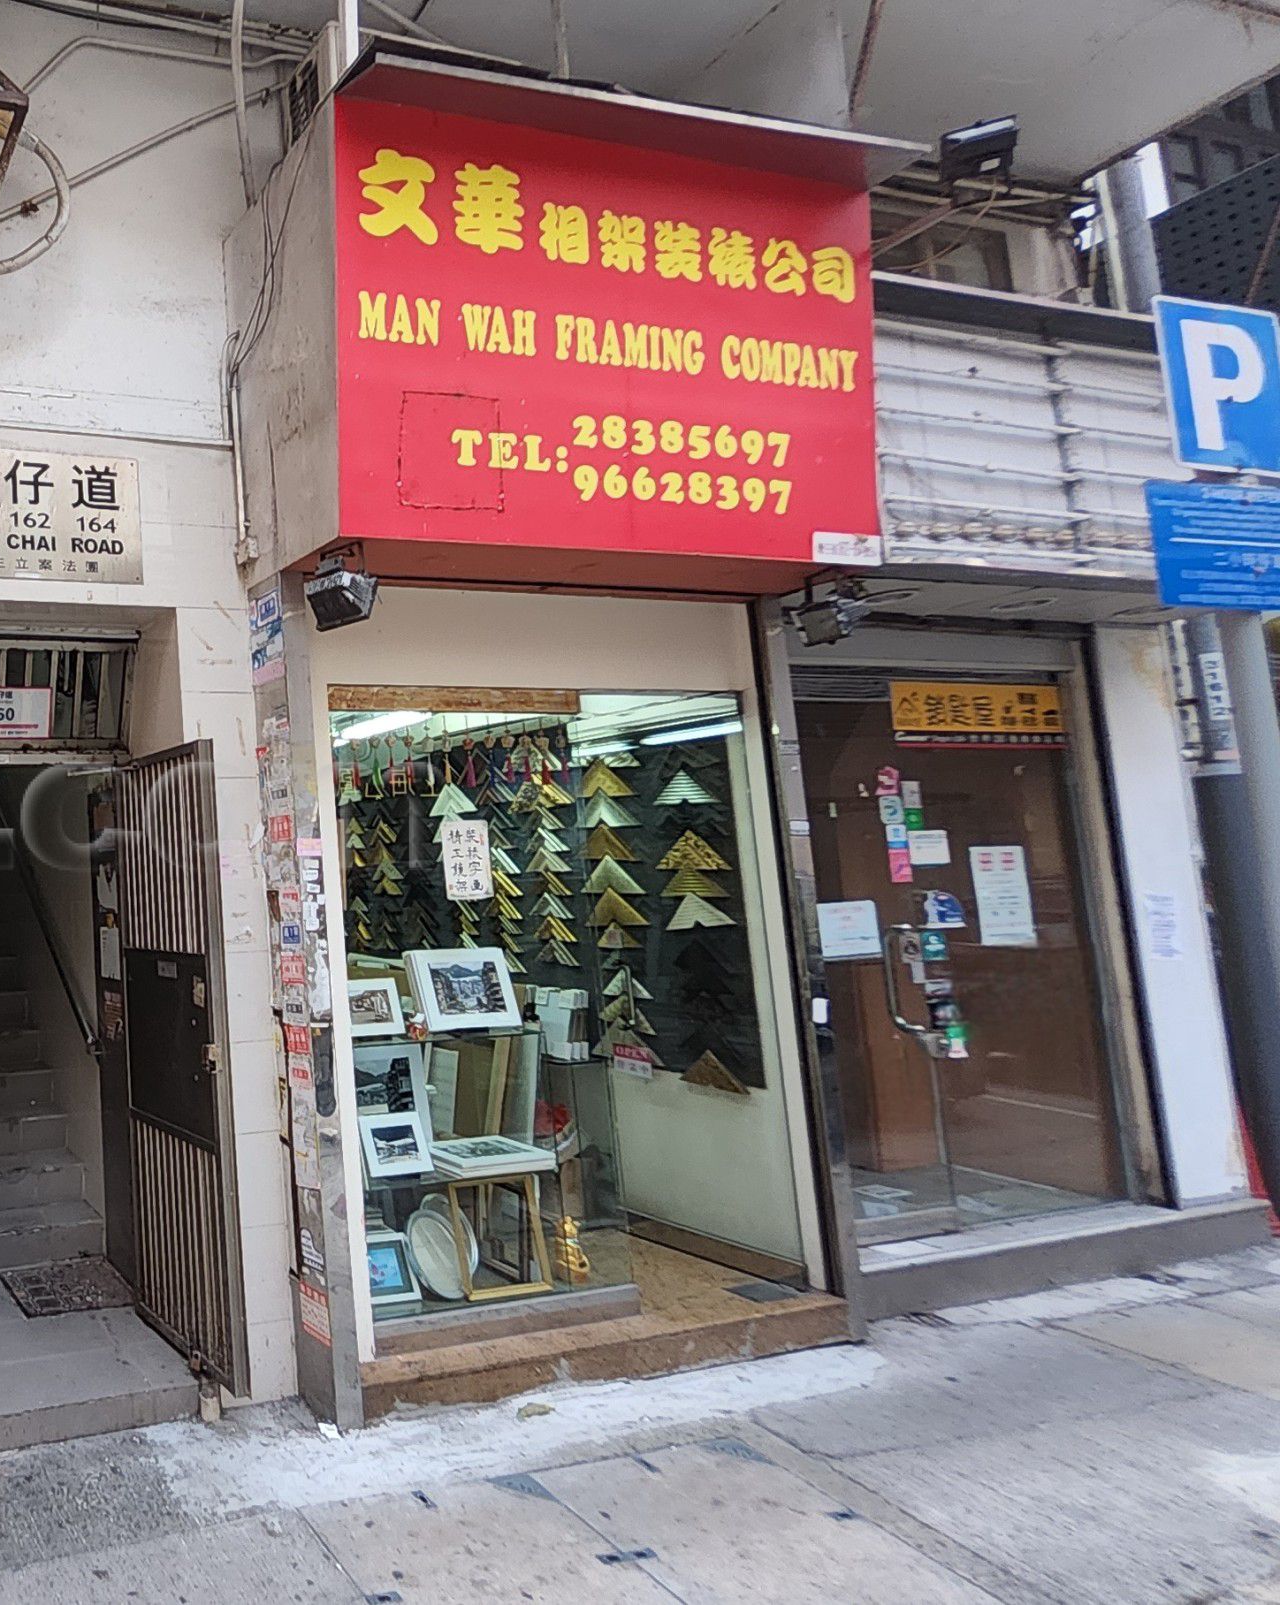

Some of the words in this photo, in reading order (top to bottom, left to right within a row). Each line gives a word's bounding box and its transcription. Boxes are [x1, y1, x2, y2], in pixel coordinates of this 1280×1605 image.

[358, 148, 857, 303] 文華相架裝裱公司
[358, 291, 441, 346] MAN
[462, 302, 537, 357] WAH
[555, 313, 705, 376] FRAMING
[721, 335, 859, 393] COMPANY
[1180, 318, 1265, 451] P
[452, 429, 569, 474] TEL:
[572, 415, 791, 467] 28385697
[573, 463, 793, 516] 96628397
[6, 533, 57, 552] CHAI
[70, 537, 125, 556] ROAD
[10, 511, 52, 530] 162
[76, 516, 118, 534] 164
[615, 1045, 649, 1060] OPEN
